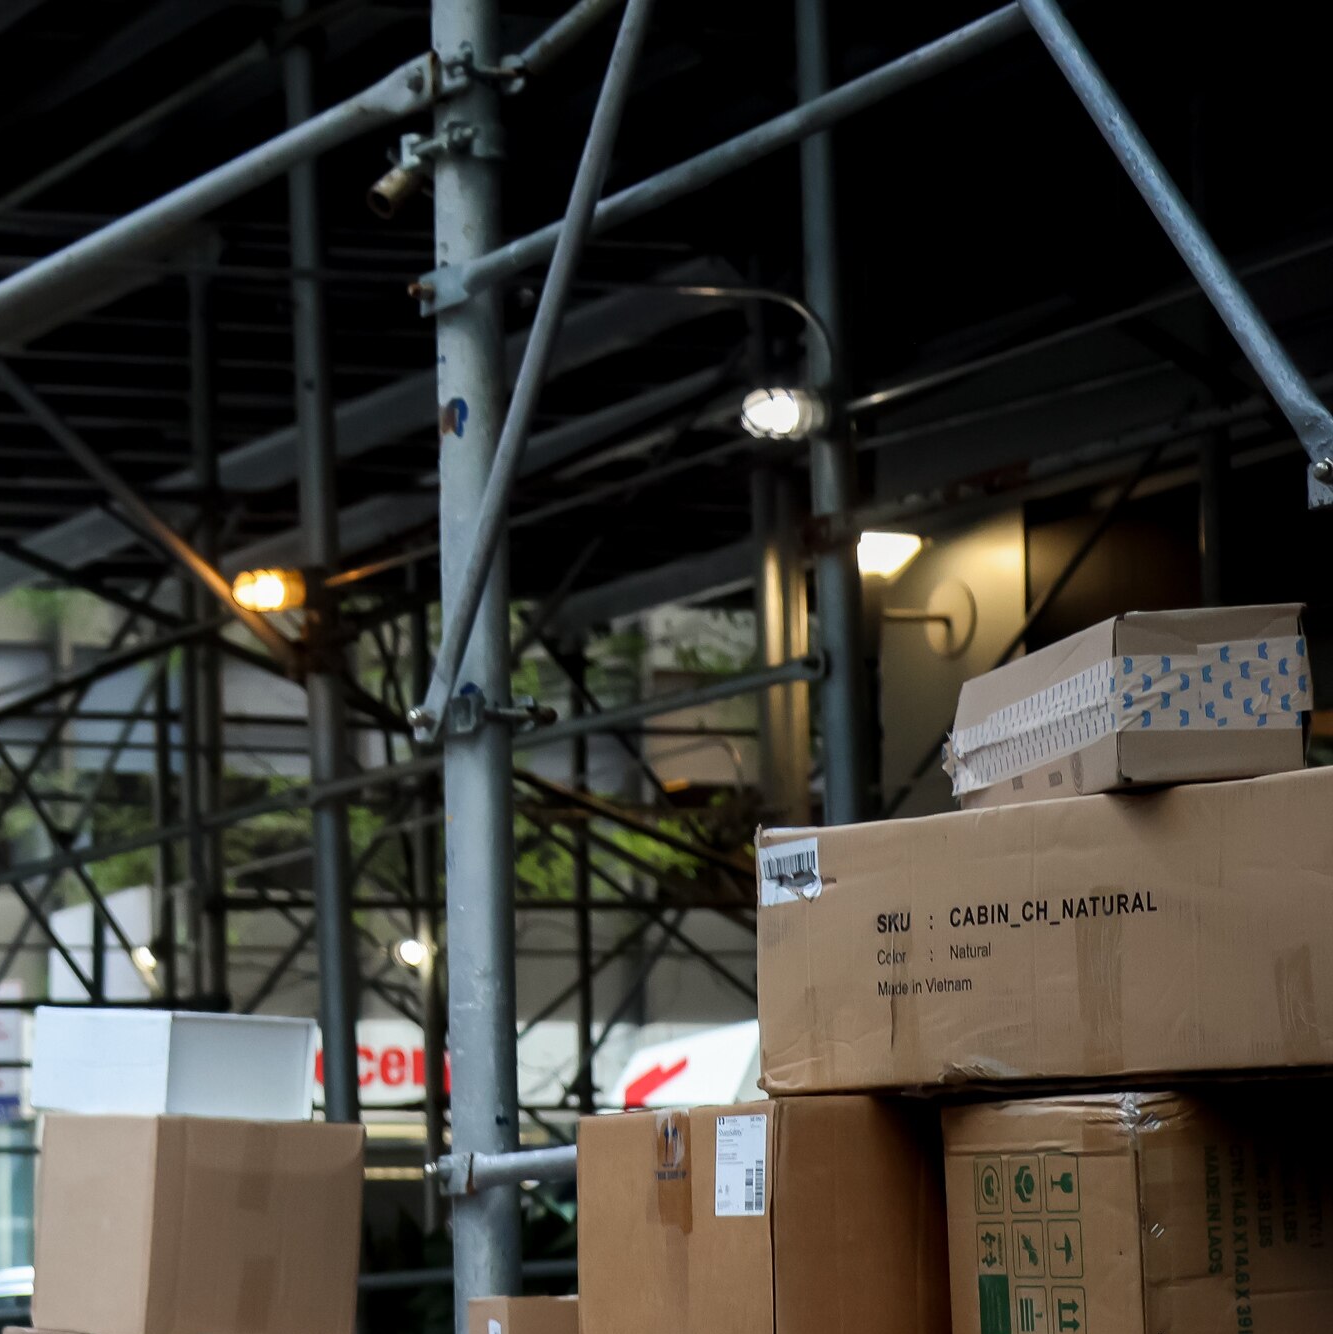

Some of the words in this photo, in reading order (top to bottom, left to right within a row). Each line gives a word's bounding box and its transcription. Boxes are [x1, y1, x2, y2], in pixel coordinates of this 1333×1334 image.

[876, 911, 911, 934] SKU
[948, 890, 1158, 929] CABIN_CH_NATURAL
[876, 947, 907, 967] Color
[949, 942, 992, 961] Natural
[877, 979, 908, 998] Made
[911, 978, 923, 995] in
[925, 974, 973, 996] Vietnam
[1204, 1144, 1221, 1199] MADE
[1206, 1203, 1221, 1222] IN
[1207, 1226, 1223, 1274] LAOS
